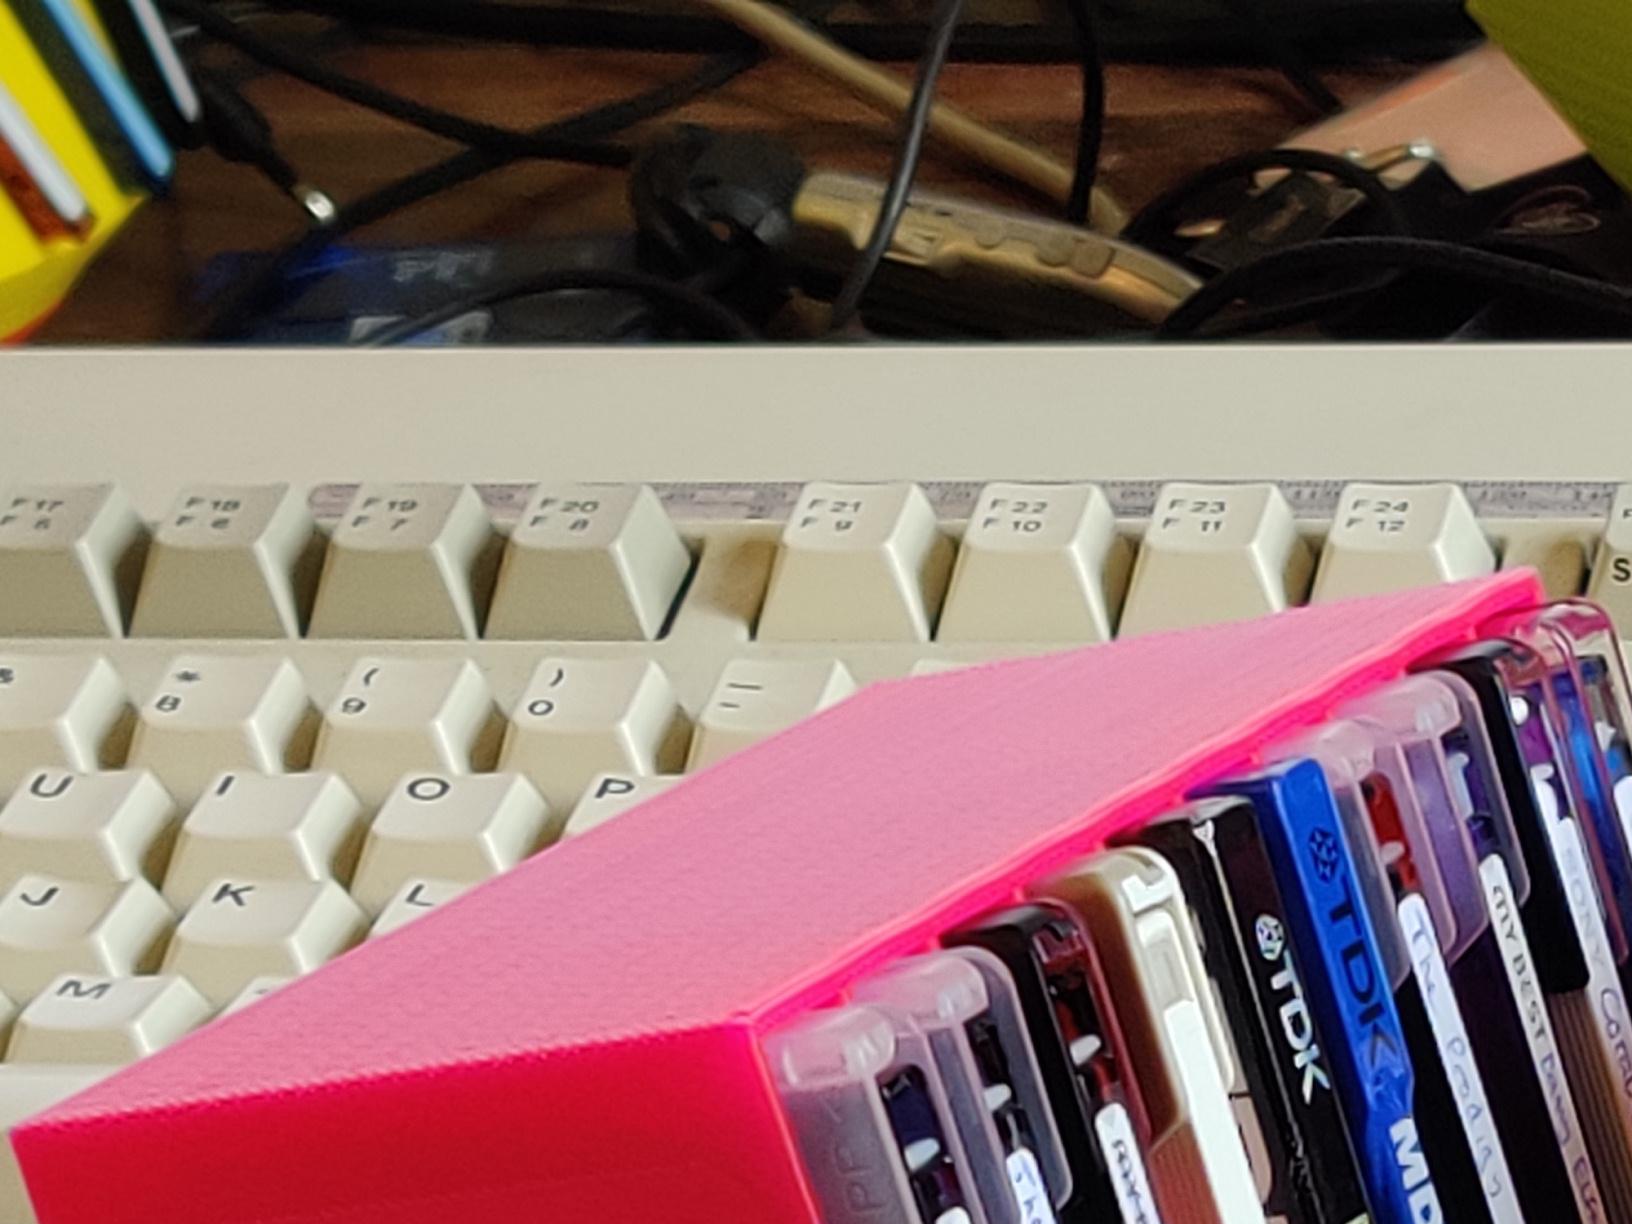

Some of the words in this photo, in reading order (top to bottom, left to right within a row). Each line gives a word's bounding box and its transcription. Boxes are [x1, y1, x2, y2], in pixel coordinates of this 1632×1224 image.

[30, 773, 73, 799] U
[595, 778, 635, 800] P
[20, 886, 60, 907] J
[212, 883, 256, 907] K
[404, 884, 436, 907] L
[1565, 847, 1604, 967] SONY
[1325, 880, 1400, 1067] TDK
[1410, 918, 1442, 1004] The
[56, 979, 112, 1000] M
[1268, 954, 1331, 1104] TDK
